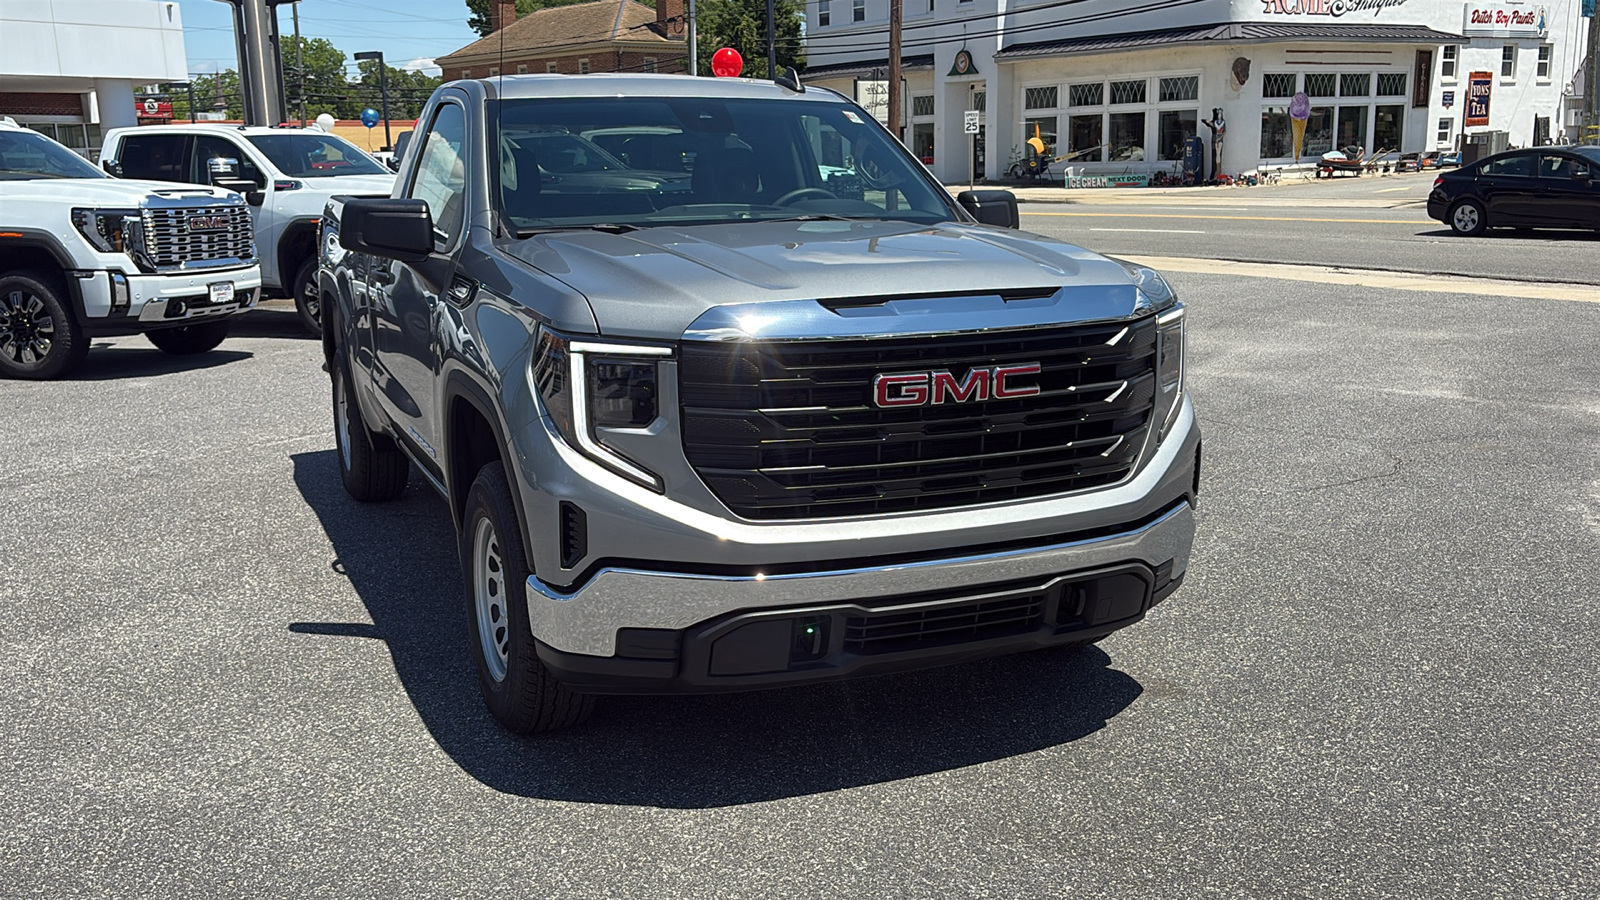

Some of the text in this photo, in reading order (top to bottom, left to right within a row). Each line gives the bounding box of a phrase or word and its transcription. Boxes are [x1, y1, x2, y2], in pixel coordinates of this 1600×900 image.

[1471, 9, 1535, 27] Dutch Boy Paints
[1471, 102, 1486, 115] TEA
[965, 122, 978, 131] 25
[1069, 177, 1080, 188] ICE
[1081, 177, 1108, 188] CREAM
[191, 215, 230, 229] GMC
[873, 361, 1041, 408] GMC
